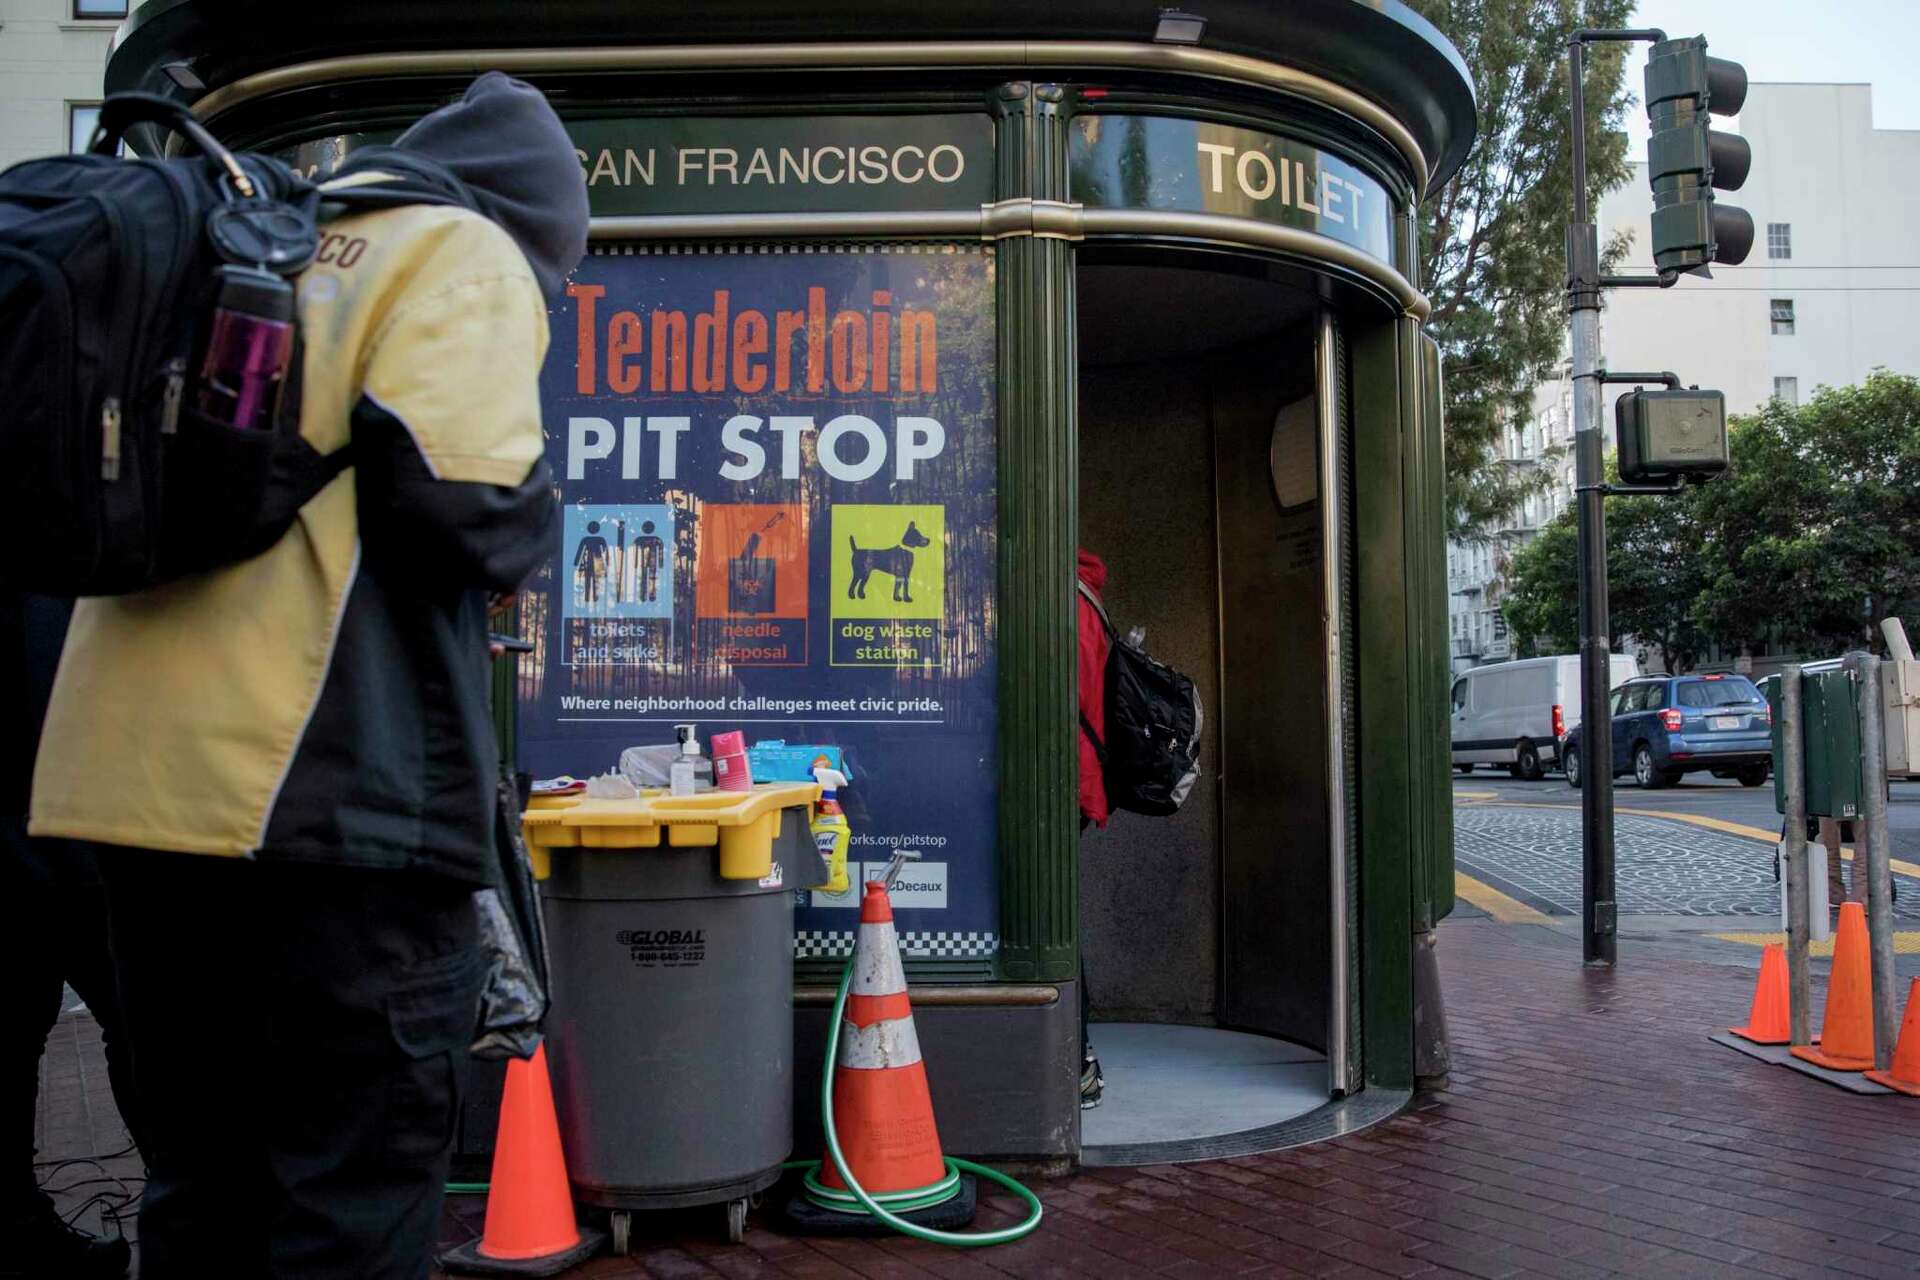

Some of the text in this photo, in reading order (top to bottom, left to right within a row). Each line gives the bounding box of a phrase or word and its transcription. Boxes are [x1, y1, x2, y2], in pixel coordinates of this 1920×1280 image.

[677, 144, 966, 185] FRANCISCO
[1197, 142, 1365, 231] TOILET
[316, 231, 368, 268] CO
[565, 284, 938, 395] Tenderloin
[566, 414, 946, 482] PIT STOP
[590, 622, 647, 637] toilets
[722, 623, 781, 637] needle
[841, 622, 933, 641] dog waste
[577, 643, 609, 659] and
[714, 644, 787, 662] disposal
[855, 645, 918, 660] station
[560, 696, 945, 715] Where neighborhood challenges meet civic pride.
[849, 833, 947, 849] orks.org/pitstop
[888, 880, 943, 892] Decaux
[631, 929, 706, 945] GLOBAL
